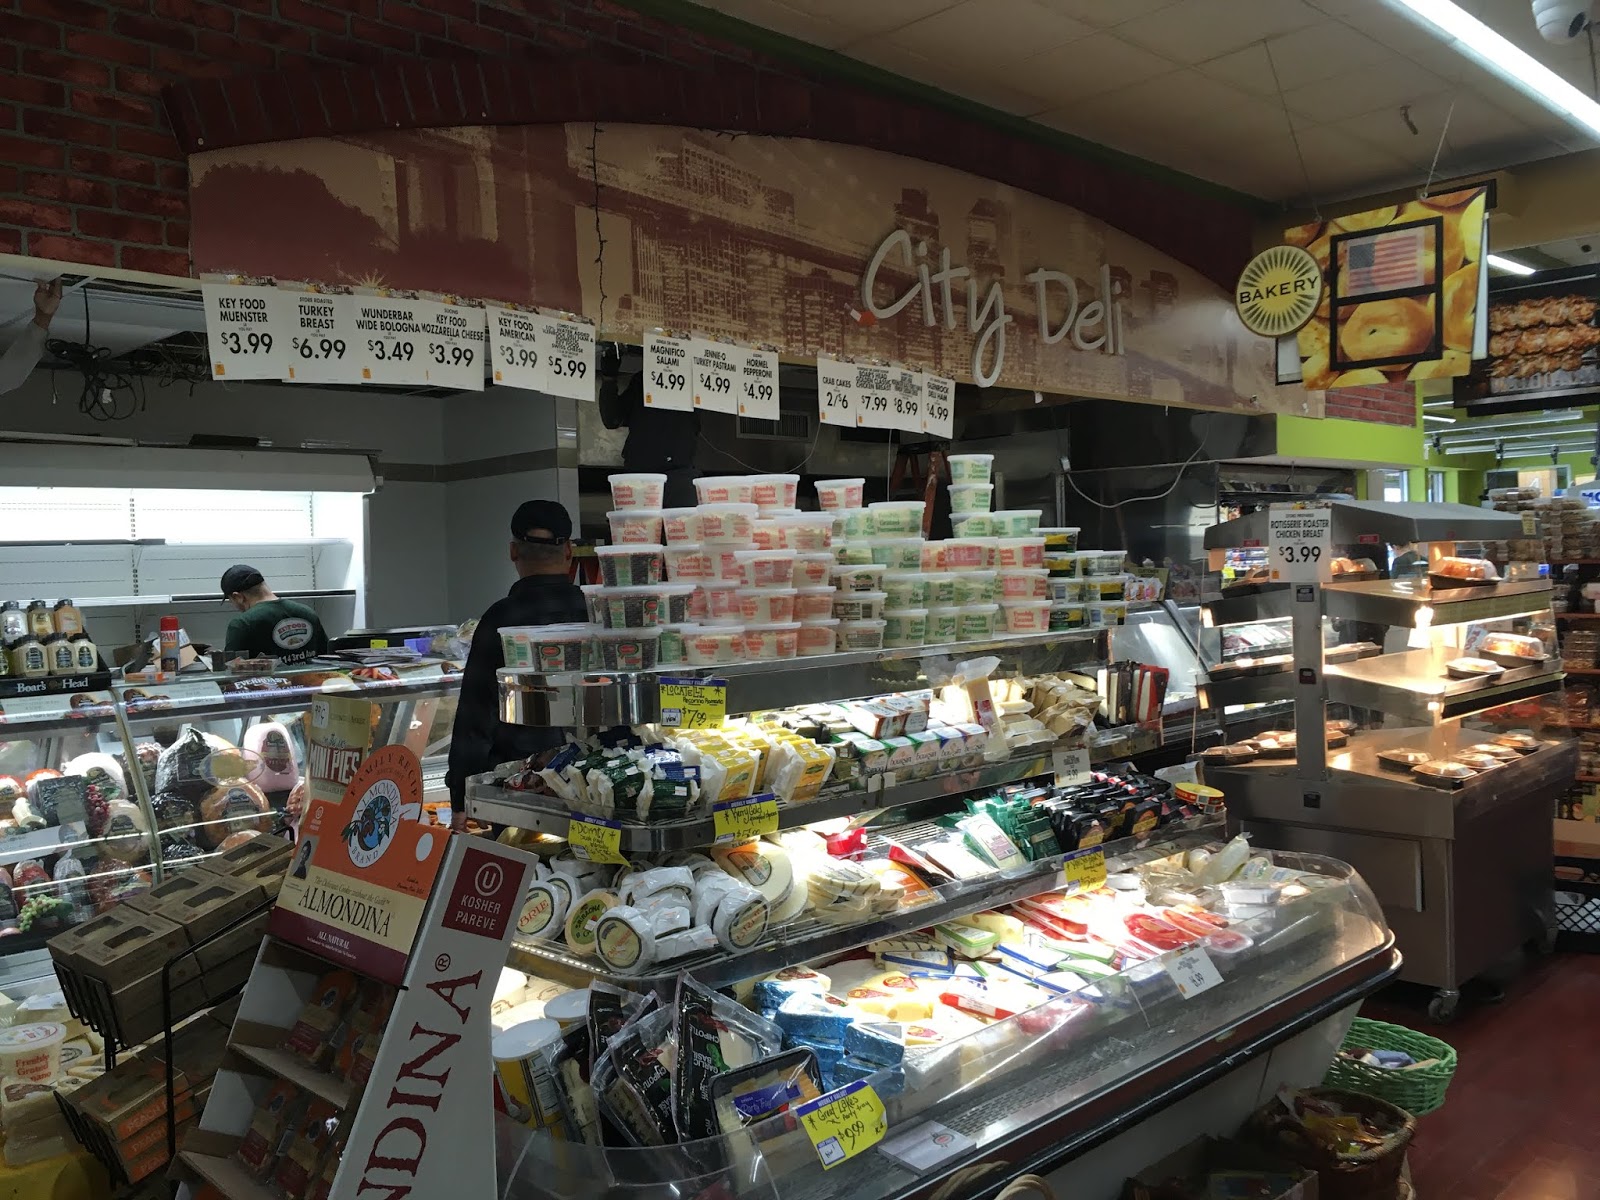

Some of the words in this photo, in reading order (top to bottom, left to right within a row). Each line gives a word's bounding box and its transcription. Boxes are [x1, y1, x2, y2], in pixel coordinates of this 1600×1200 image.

[1239, 275, 1319, 304] BAKERY
[218, 297, 236, 309] KEY
[239, 298, 266, 310] FOOD
[298, 304, 335, 317] TURKEY
[861, 229, 1013, 389] City
[1025, 263, 1125, 355] Deli
[219, 310, 268, 323] MUENSTER
[360, 307, 414, 321] WUNDERBAR
[435, 313, 448, 325] KEY
[448, 315, 467, 328] FOOD
[300, 318, 335, 330] BREAST
[355, 319, 379, 331] WIDE
[380, 321, 421, 334] BOLOGNA
[421, 322, 460, 339] MOZZARELLA
[461, 327, 484, 342] CHEESE
[498, 316, 511, 328] KEY
[511, 318, 534, 332] FOOD
[220, 331, 273, 355] $3.99
[499, 327, 536, 343] AMERICAN
[292, 337, 346, 360] $6.99
[367, 338, 414, 362] $3.49
[428, 342, 474, 368] $3.99
[500, 345, 538, 369] $3.99
[650, 345, 685, 358] MAGNIFICO
[548, 355, 587, 379] $5.99
[656, 356, 680, 367] SALAMI
[693, 356, 712, 368] TURKEY
[712, 360, 737, 373] PASTRAMI
[746, 358, 769, 369] HORMEL
[651, 371, 685, 391] $4.99
[743, 367, 773, 379] PEPPERONI
[699, 373, 731, 394] $4.99
[822, 376, 835, 385] CRAB
[835, 379, 852, 388] CAKES
[743, 382, 773, 401] $4.99
[861, 394, 888, 411] $7.99
[893, 397, 918, 416] $8.99
[926, 403, 949, 421] $4.99
[1270, 520, 1302, 529] ROTISSERIE
[1303, 519, 1330, 528] ROASTER
[1275, 529, 1301, 539] CHICKEN
[1302, 529, 1325, 538] BREAST
[1278, 546, 1322, 563] $3.99
[160, 632, 176, 642] PAM
[17, 681, 47, 693] Boar's
[62, 677, 89, 689] Head
[310, 743, 331, 778] MINI
[331, 749, 360, 785] PIES
[350, 753, 394, 797] FAMILY
[399, 754, 418, 803] RECIP
[356, 782, 400, 826] ALMONDINA
[351, 846, 379, 864] BRAND
[298, 885, 391, 938] ALMONDINA
[460, 894, 501, 915] KOSHER
[519, 899, 550, 927] BRIE
[455, 910, 497, 931] PAREVE
[317, 931, 328, 941] ALL
[327, 934, 351, 950] NATURAL
[688, 1024, 720, 1044] CHIPOTLE
[15, 1053, 50, 1068] Freshly
[692, 1050, 712, 1064] BASIL
[17, 1062, 49, 1076] Grated
[693, 1058, 719, 1074] GARLIC
[817, 1095, 834, 1107] WEEKLY
[817, 1103, 840, 1121] Great
[838, 1096, 859, 1114] Lakes
[856, 1101, 874, 1113] tray
